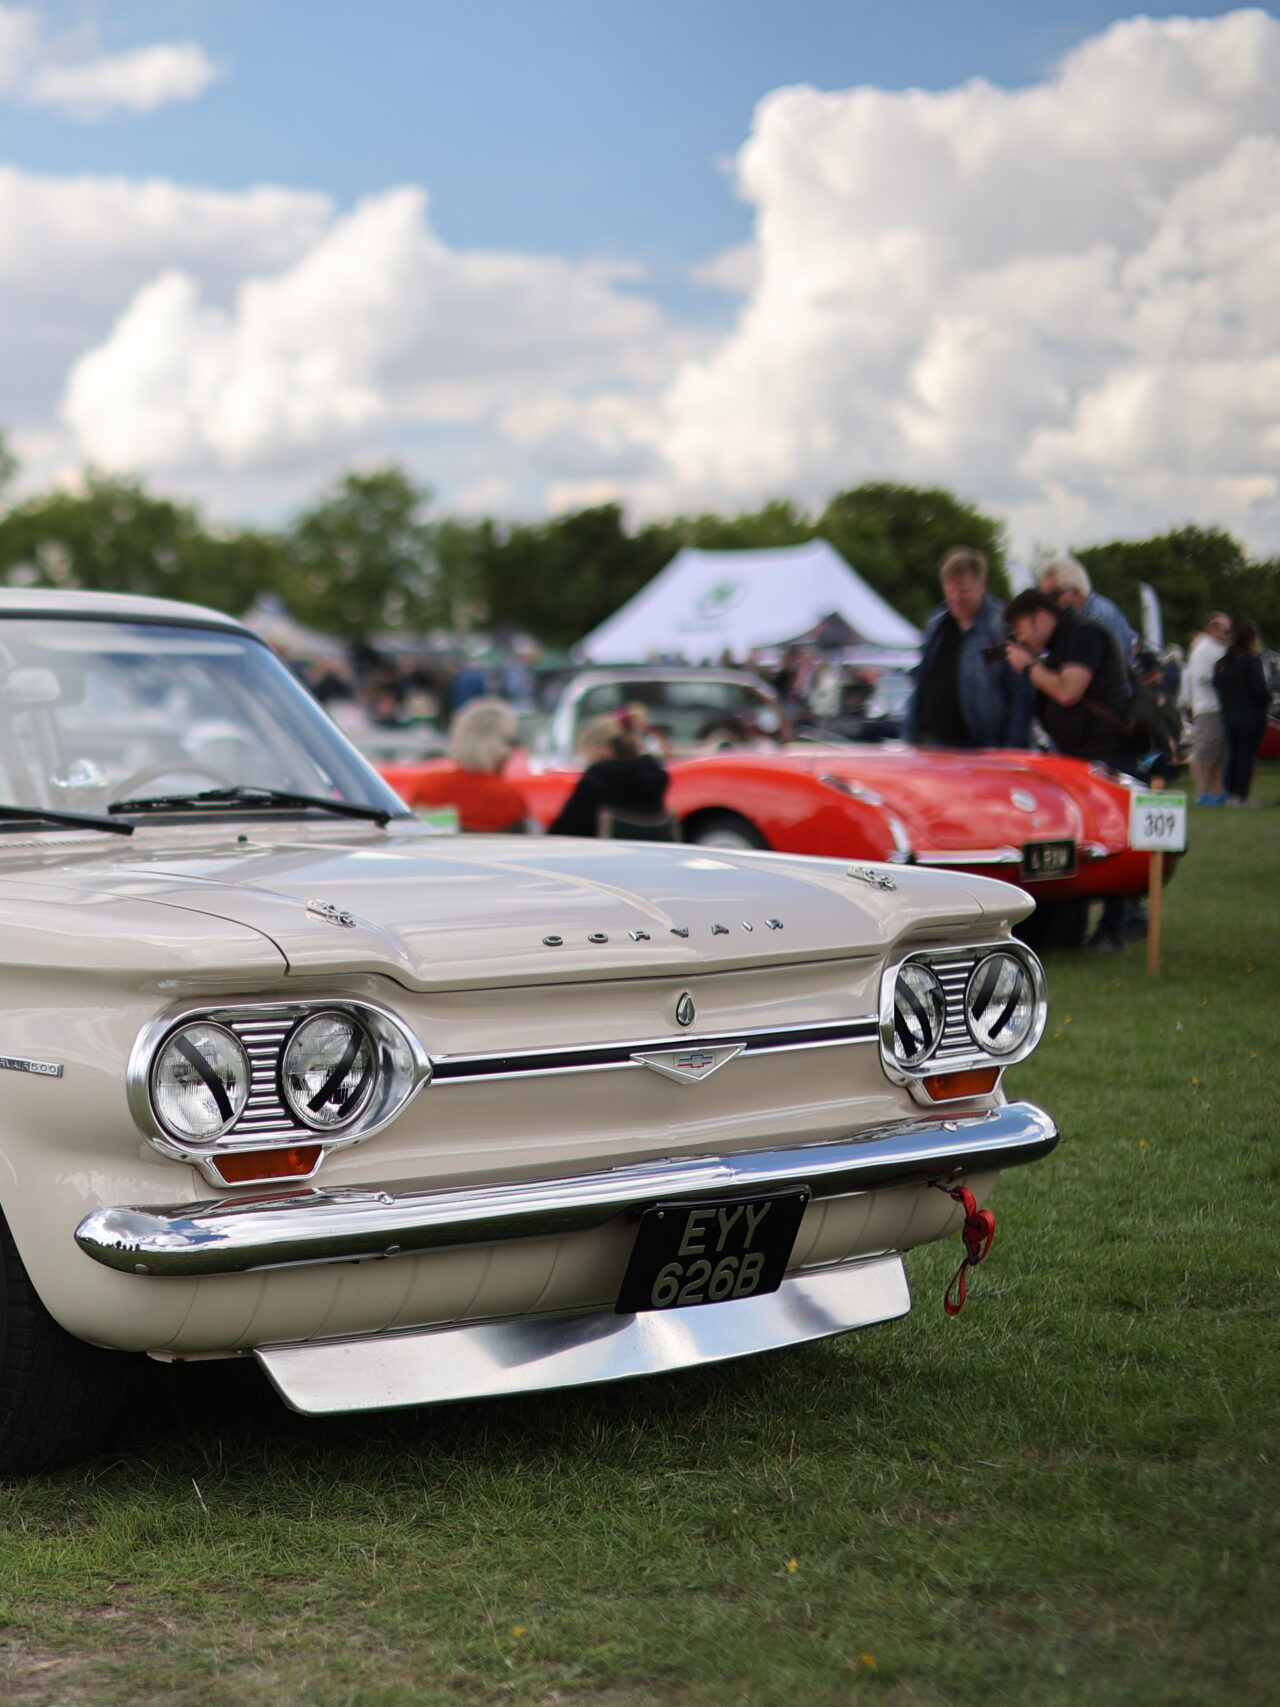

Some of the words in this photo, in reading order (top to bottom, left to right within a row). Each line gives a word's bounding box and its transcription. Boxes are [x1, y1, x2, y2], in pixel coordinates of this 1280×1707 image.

[1143, 813, 1176, 838] 309
[542, 918, 784, 947] CORVAIR
[30, 1062, 58, 1074] 500
[677, 1201, 772, 1257] EYY
[650, 1251, 766, 1308] 626B
